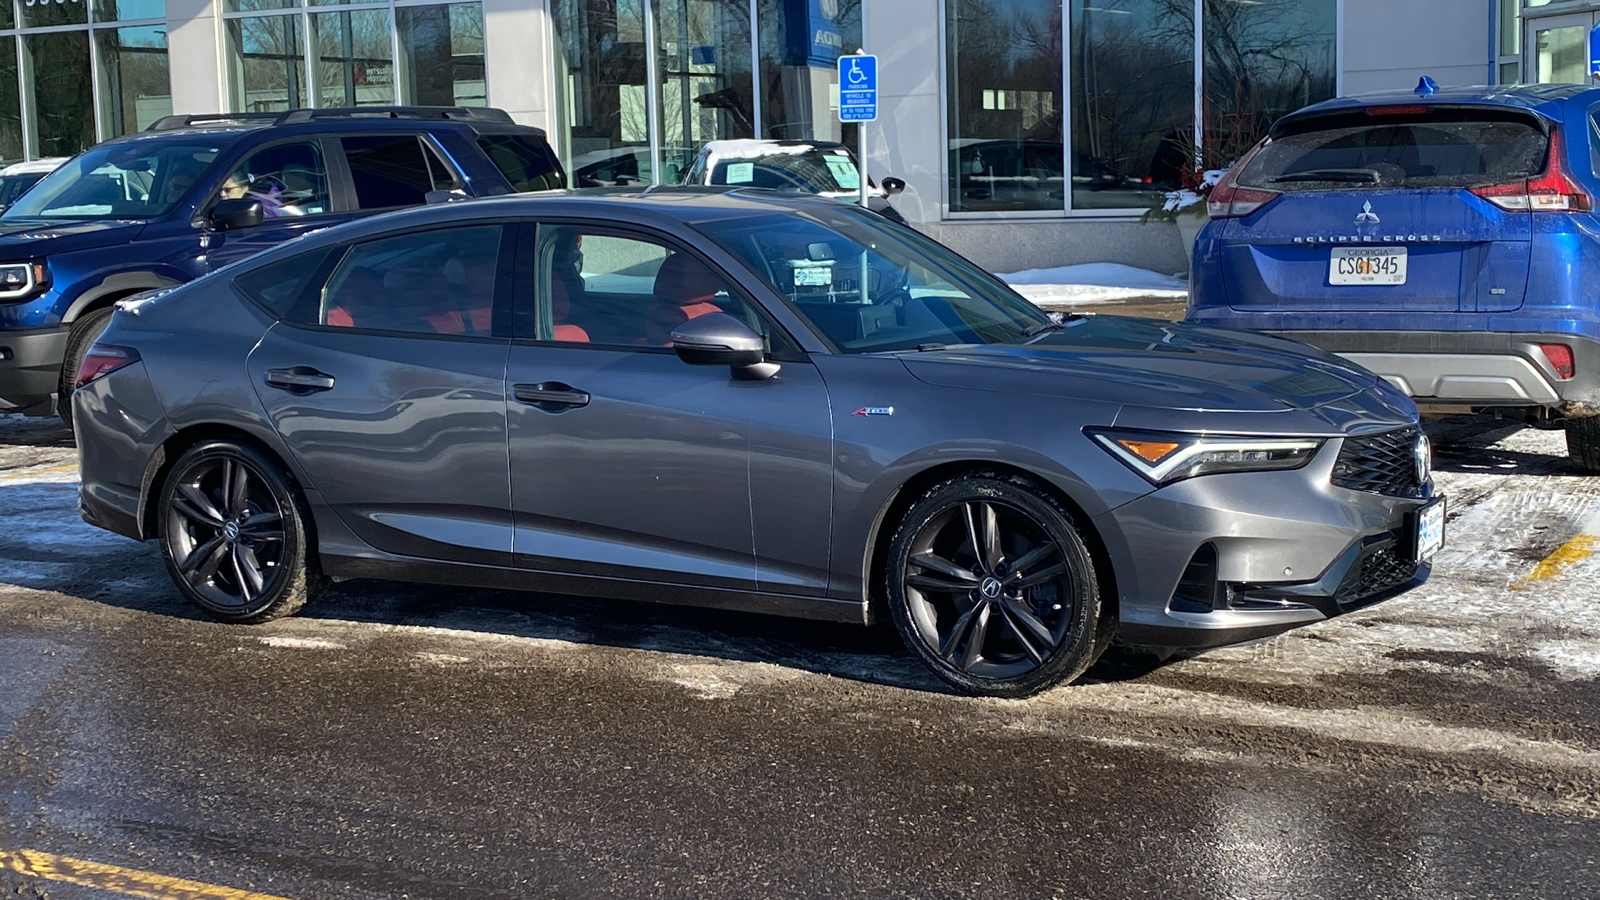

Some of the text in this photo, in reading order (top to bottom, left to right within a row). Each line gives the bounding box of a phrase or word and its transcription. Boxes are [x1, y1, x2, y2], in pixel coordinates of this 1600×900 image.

[1294, 234, 1440, 243] ECLIPSE CROSS
[1338, 257, 1398, 275] CSG1345
